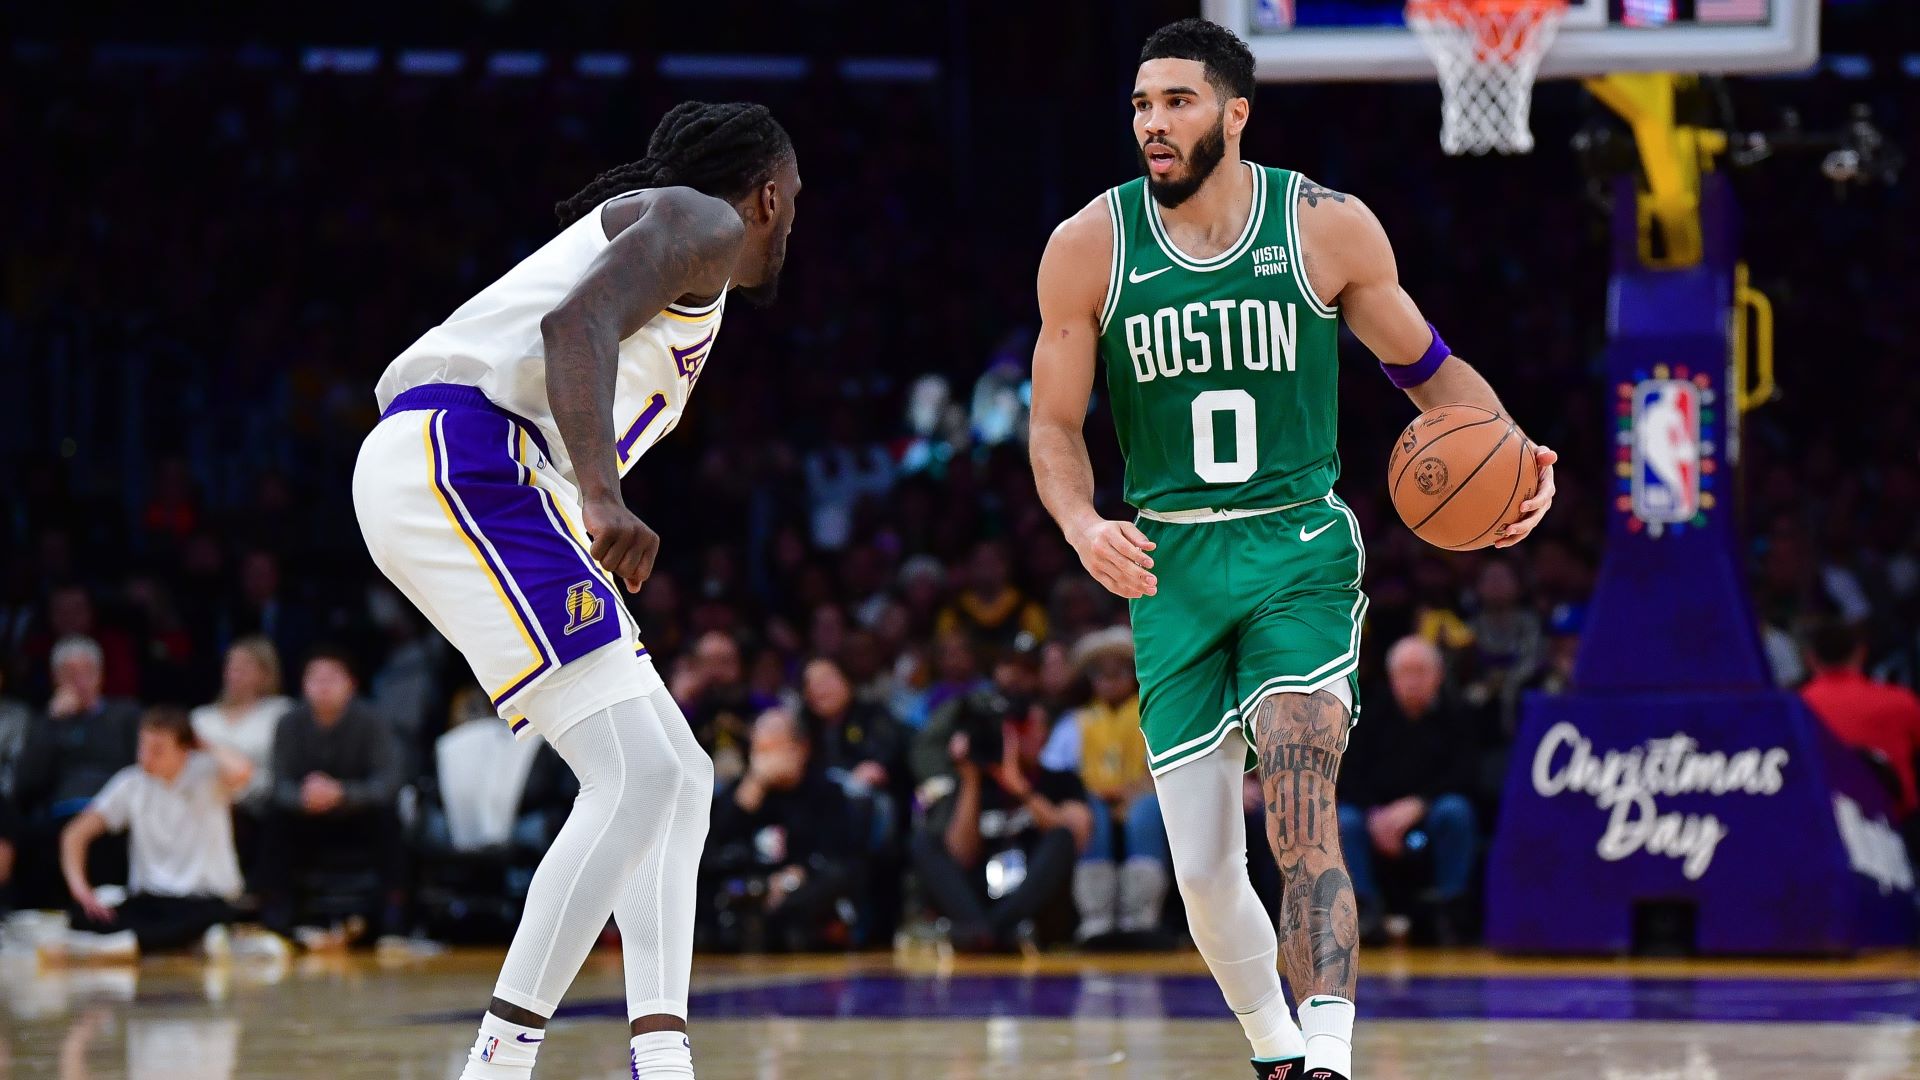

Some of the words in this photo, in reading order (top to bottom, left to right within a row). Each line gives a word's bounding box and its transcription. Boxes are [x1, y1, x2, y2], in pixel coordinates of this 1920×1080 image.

[1252, 246, 1287, 265] VISTA
[1254, 262, 1289, 277] PRINT
[1125, 299, 1296, 383] BOSTON
[1191, 389, 1258, 484] 0
[1260, 744, 1339, 785] RATEFUL
[1532, 721, 1789, 809] Christmas
[1597, 789, 1728, 880] Day
